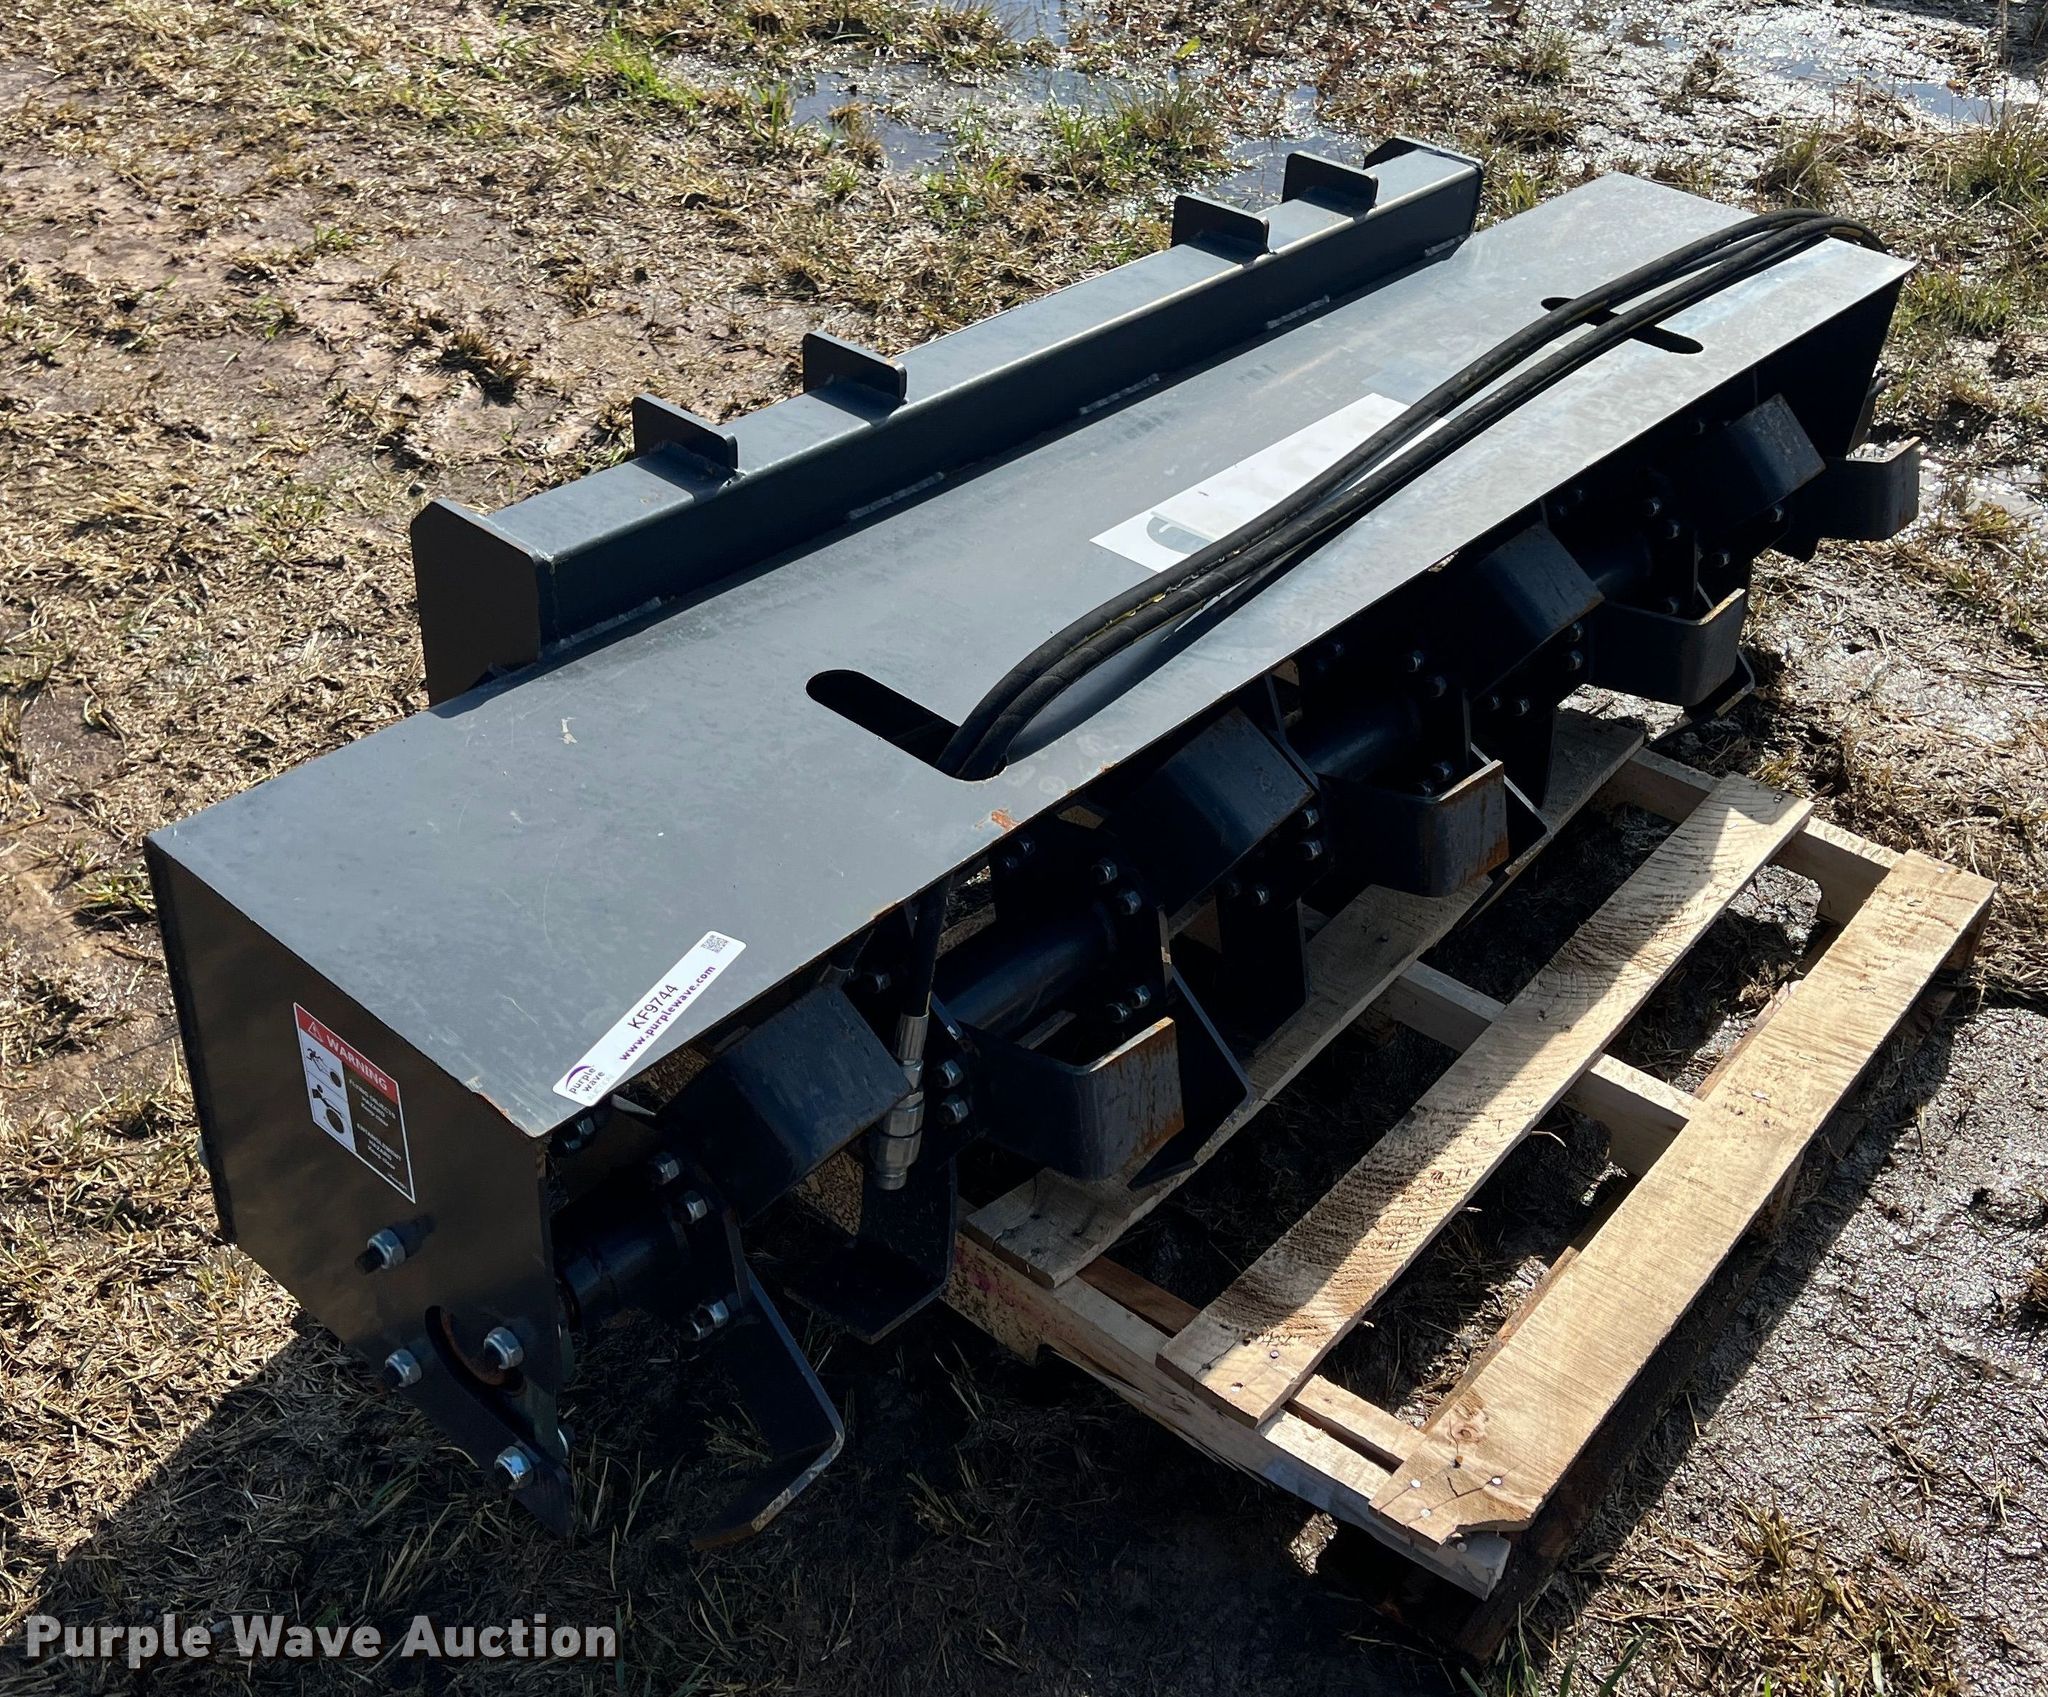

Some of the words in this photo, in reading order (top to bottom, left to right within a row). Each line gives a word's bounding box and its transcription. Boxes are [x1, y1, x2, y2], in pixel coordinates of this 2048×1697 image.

[618, 965, 716, 1061] www.purplewave.com
[628, 984, 679, 1028] KF9744
[327, 1035, 387, 1091] WARNING
[568, 1067, 597, 1094] purple
[582, 1071, 605, 1092] wave
